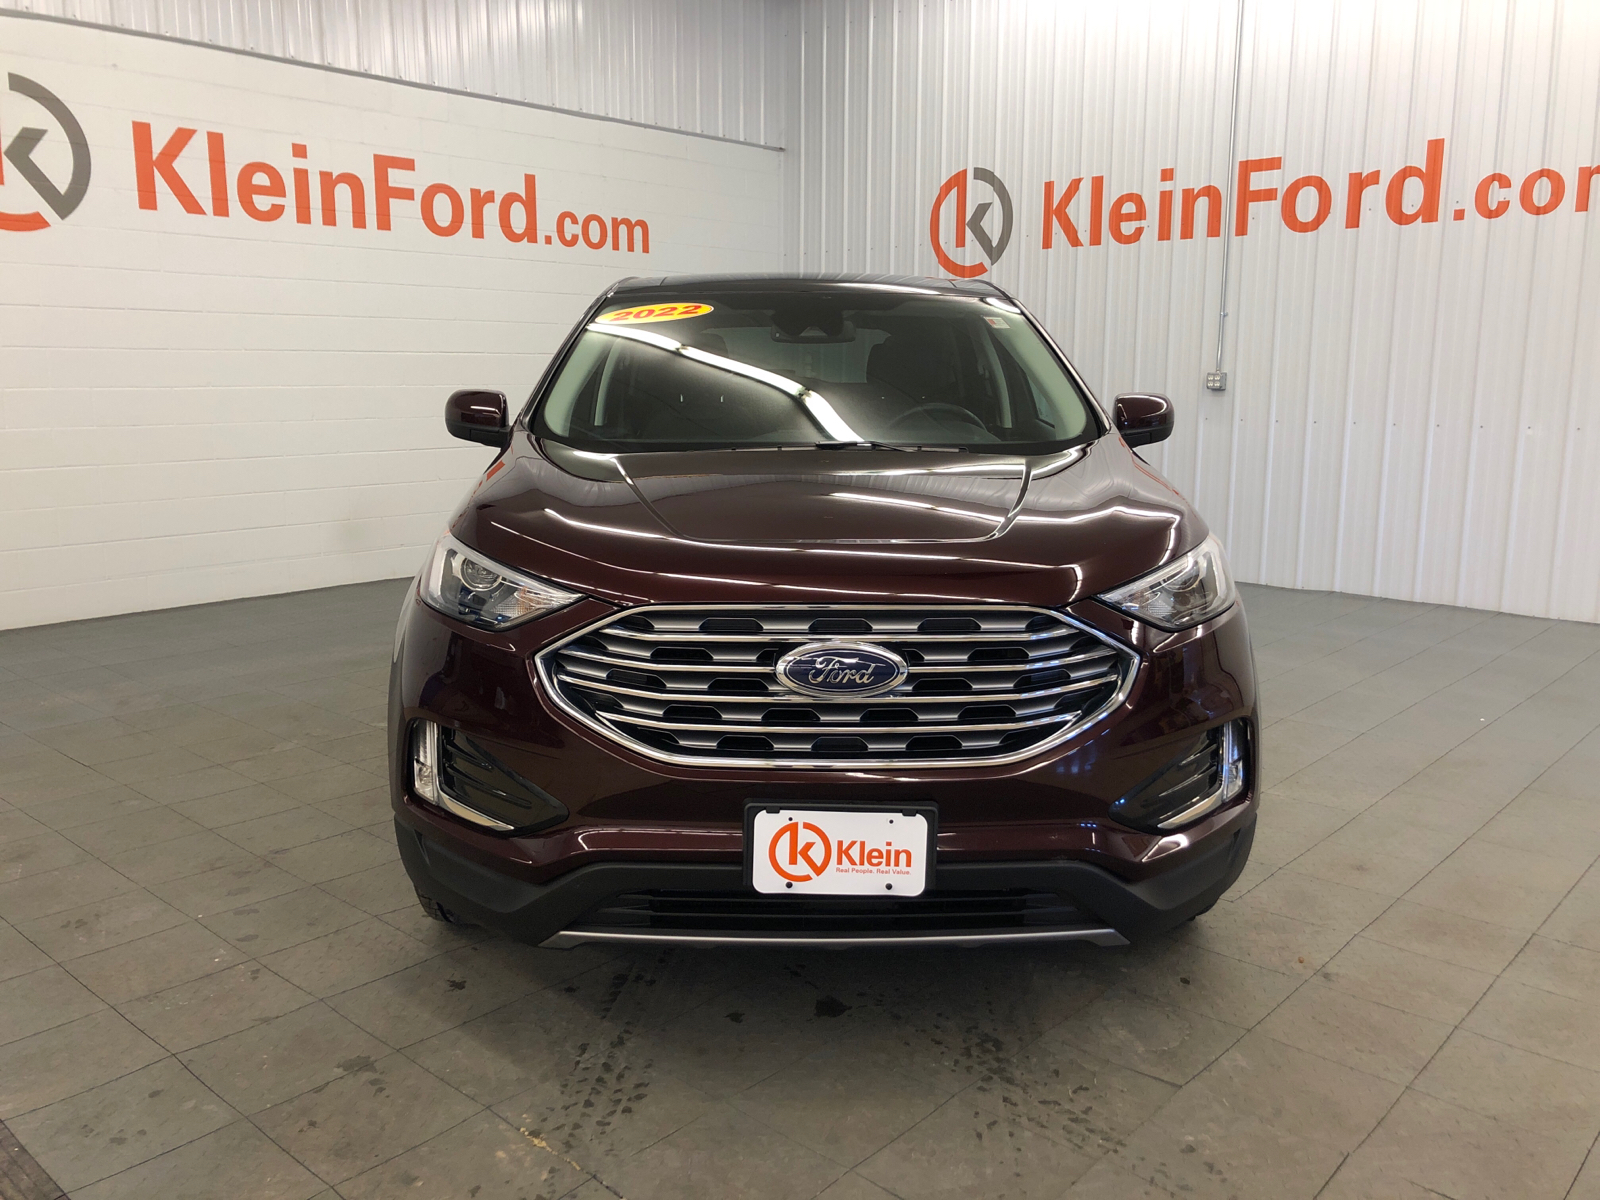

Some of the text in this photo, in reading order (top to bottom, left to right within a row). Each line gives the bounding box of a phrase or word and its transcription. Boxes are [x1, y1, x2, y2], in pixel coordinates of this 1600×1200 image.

[132, 121, 649, 254] KleinFord.com
[610, 304, 702, 322] 2022
[808, 655, 877, 684] Ford
[836, 840, 912, 867] Klein
[851, 867, 875, 875] People.
